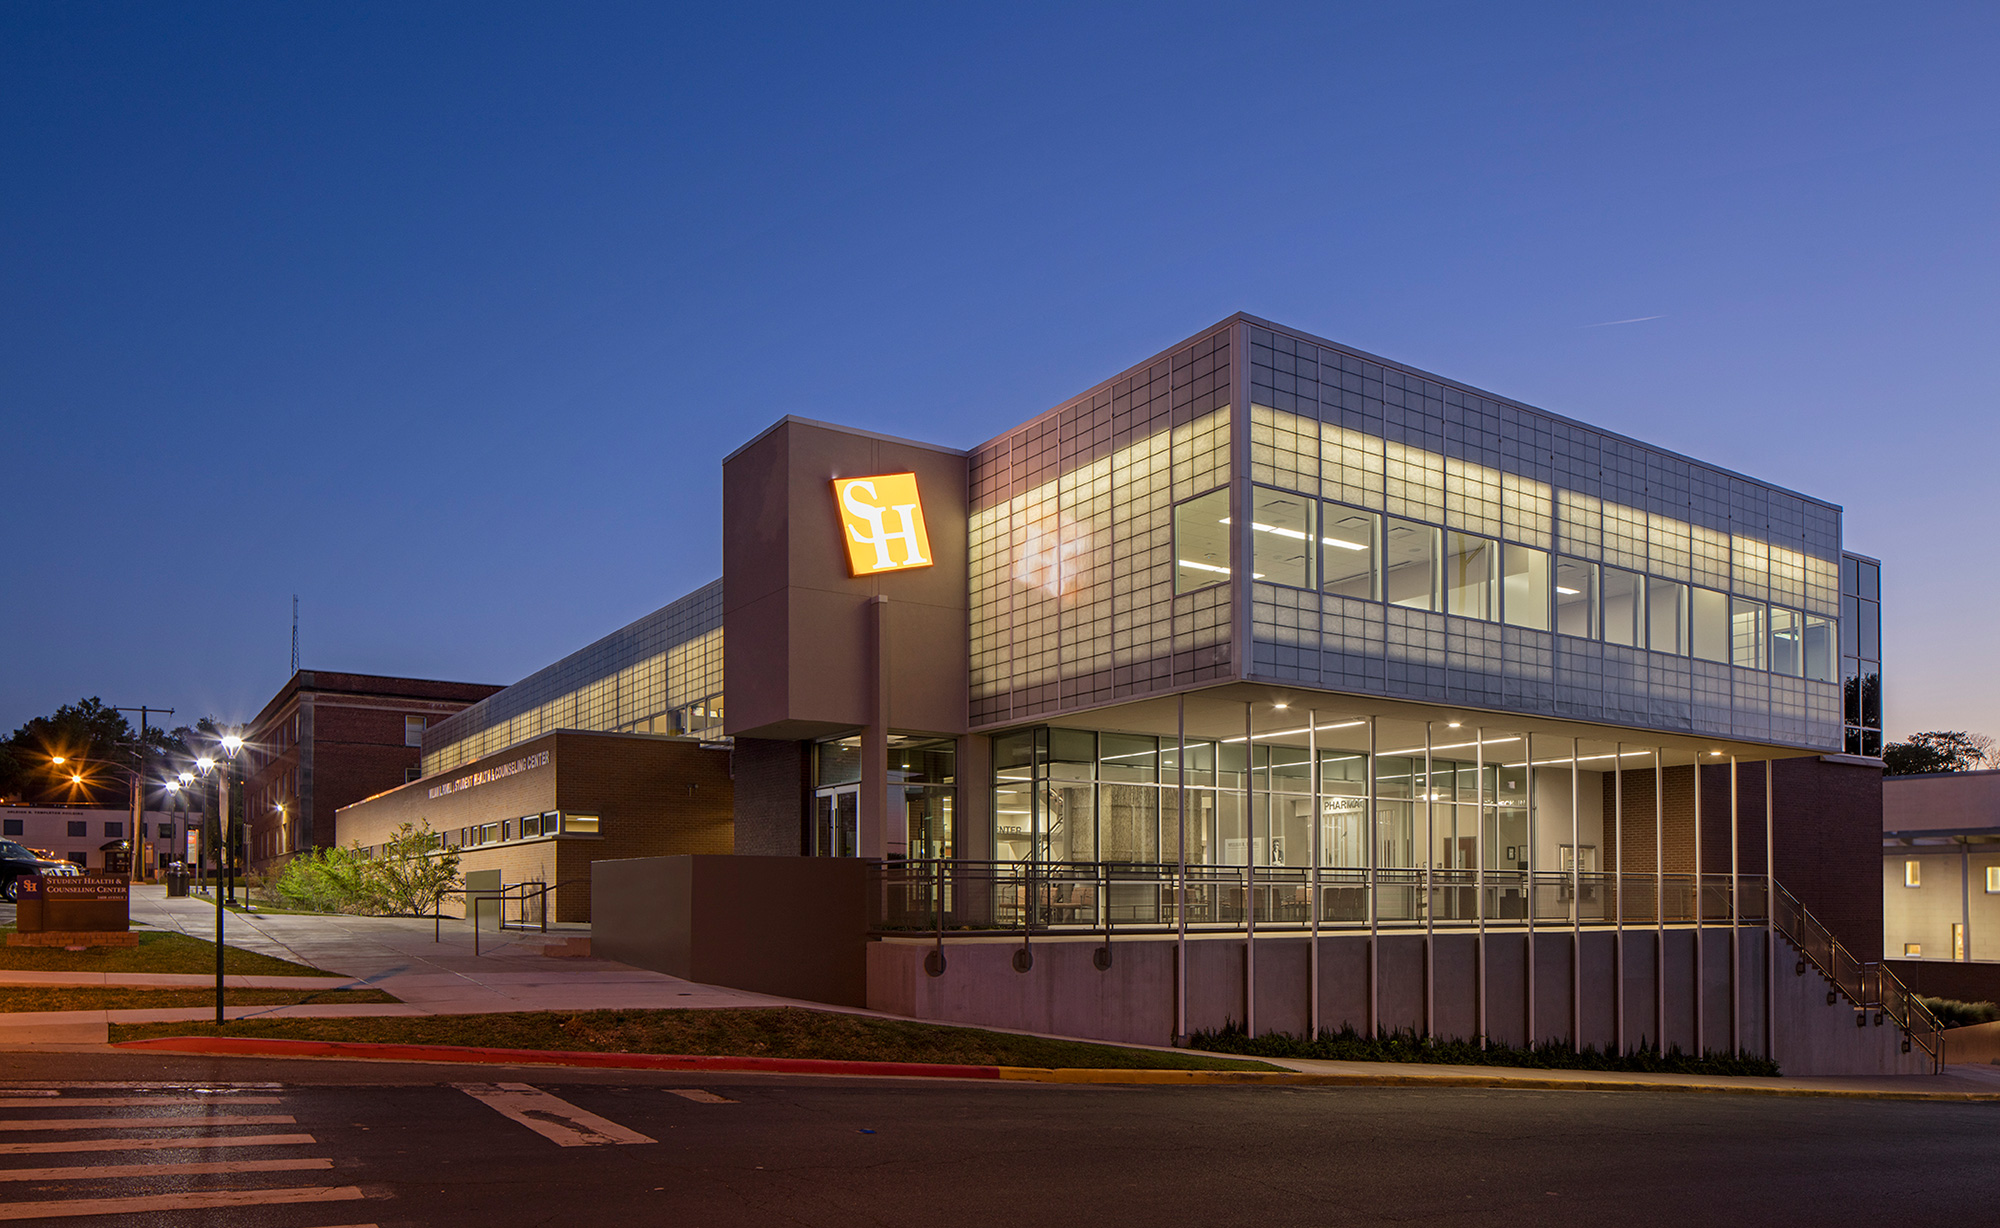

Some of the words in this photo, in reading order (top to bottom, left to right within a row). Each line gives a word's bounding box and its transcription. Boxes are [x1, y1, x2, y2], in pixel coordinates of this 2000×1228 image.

[455, 775, 473, 792] STUDENT
[473, 769, 490, 786] HEALTH
[495, 758, 526, 780] COUNSELING
[527, 750, 550, 770] CENTER
